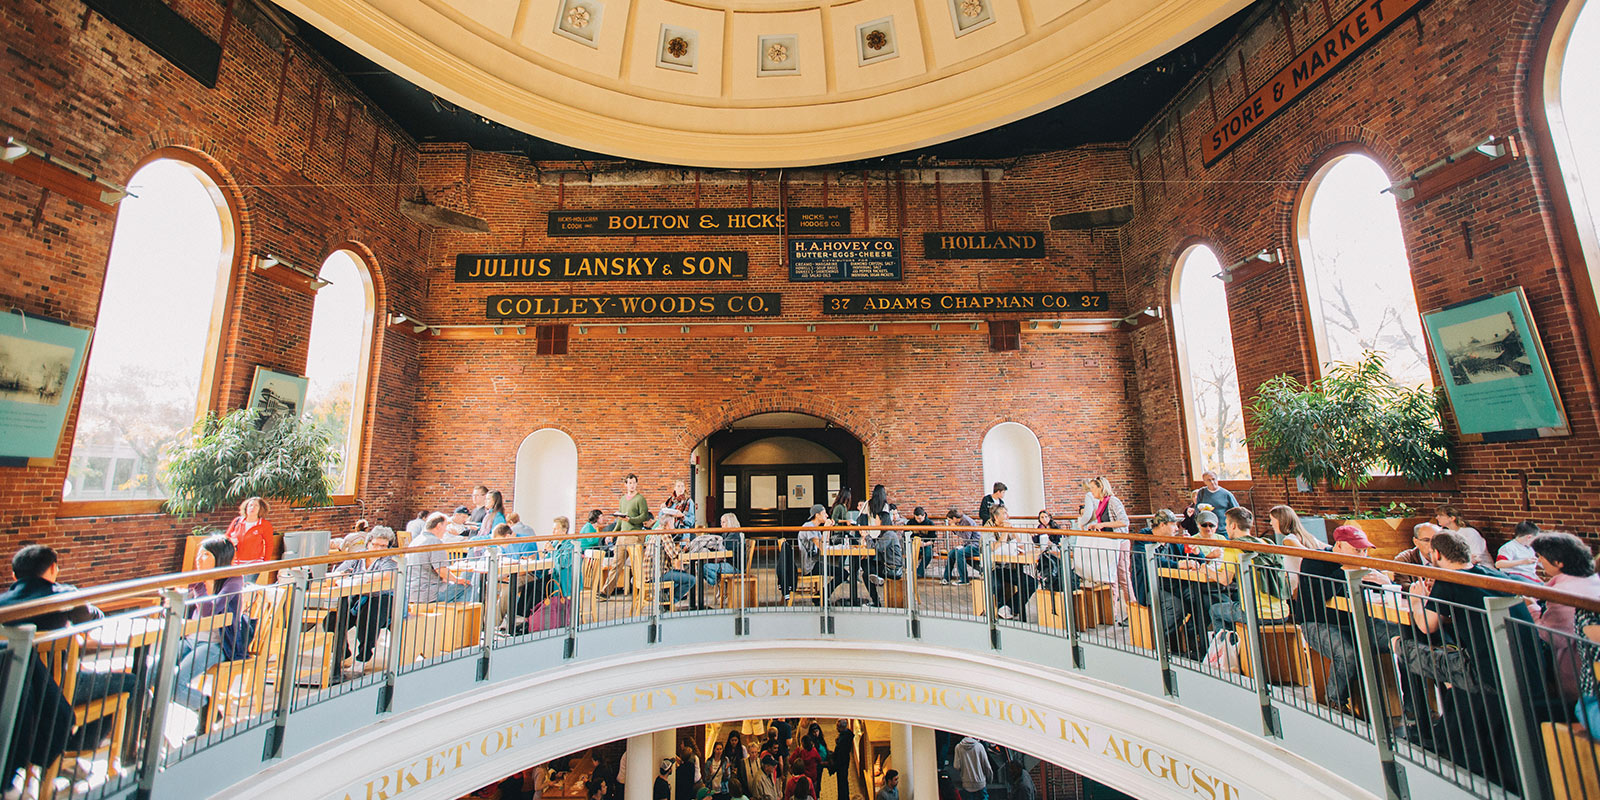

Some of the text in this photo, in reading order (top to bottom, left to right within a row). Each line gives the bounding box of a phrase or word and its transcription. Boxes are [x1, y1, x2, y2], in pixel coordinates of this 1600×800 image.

[1211, 0, 1384, 151] STORE & MARKET
[608, 213, 786, 230] BOLTON & HICKS
[874, 241, 895, 250] CO.
[940, 235, 1037, 250] HOLLAND
[468, 256, 733, 278] JULIUS LANSKY & SON
[496, 296, 769, 316] COLLEY-WOODS CO.
[831, 298, 850, 310] 37
[863, 296, 932, 310] ADAMS
[940, 295, 1034, 310] CHAPMAN
[1081, 294, 1100, 307] 37
[343, 678, 1239, 800] RKET OF THE CITY SINCE ITS DEDICATION IN AUGUST
